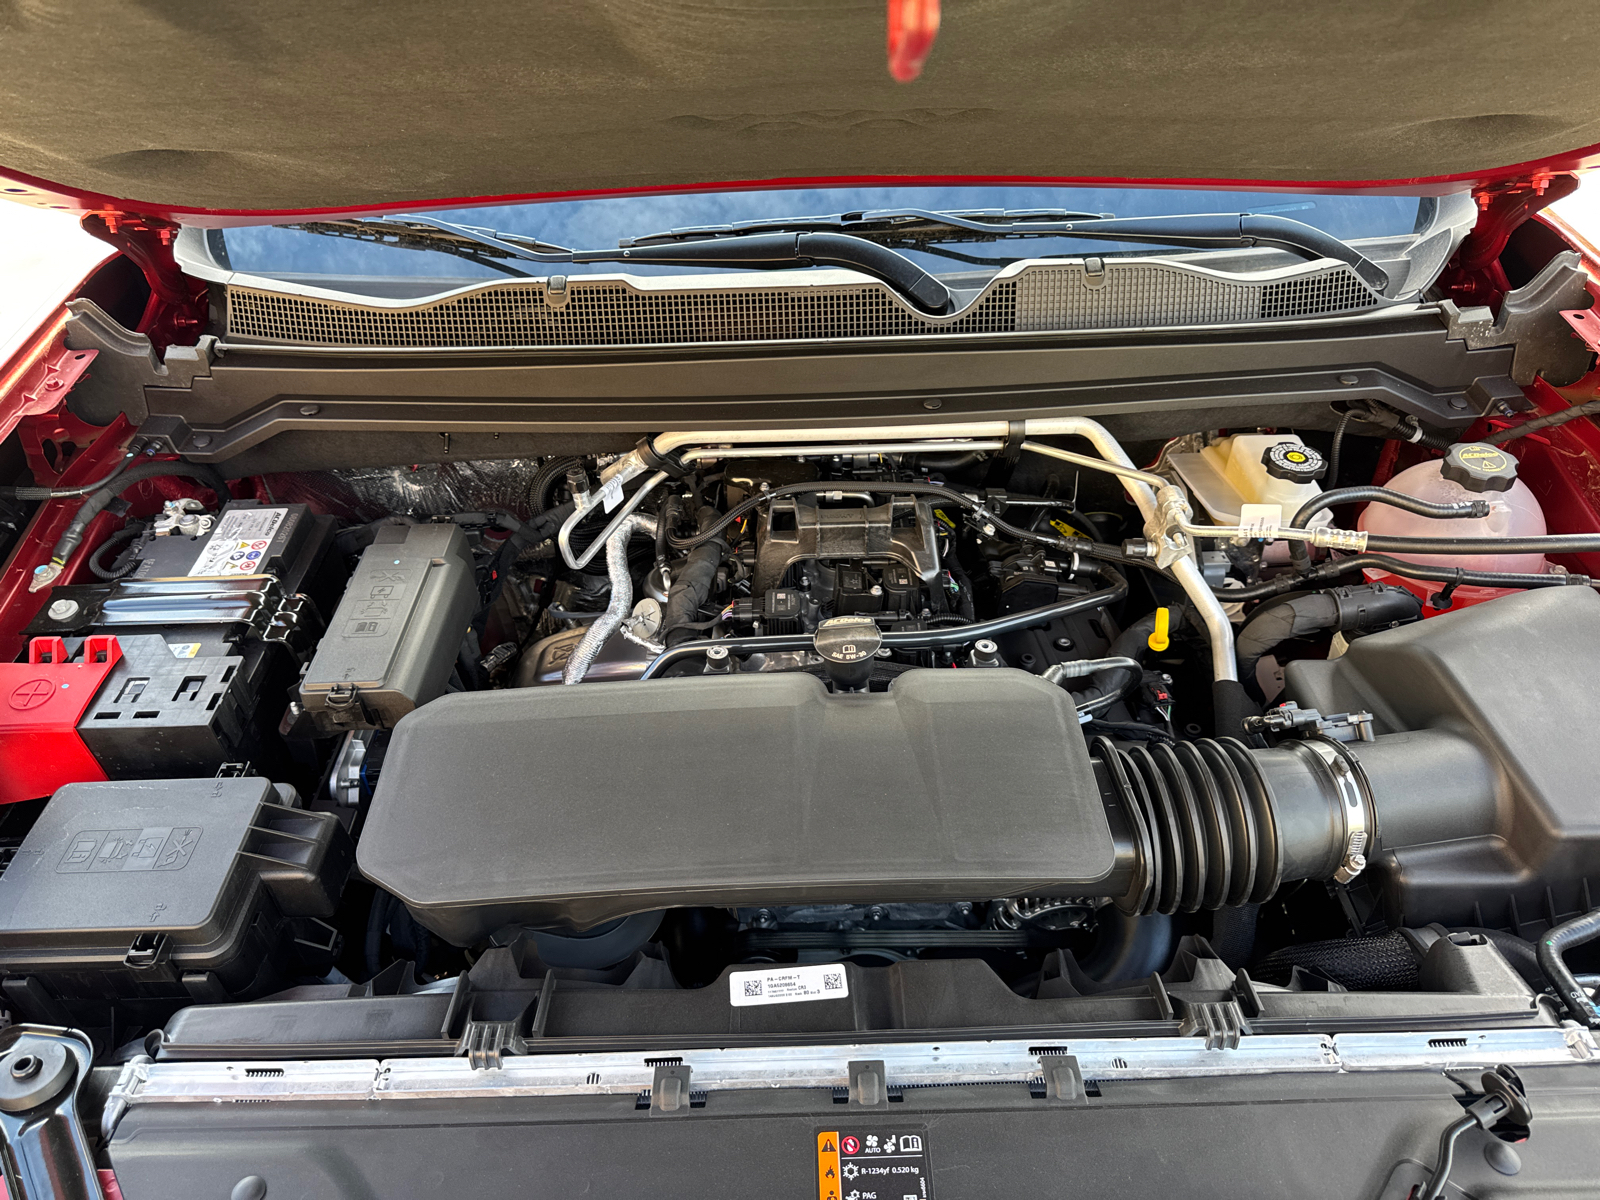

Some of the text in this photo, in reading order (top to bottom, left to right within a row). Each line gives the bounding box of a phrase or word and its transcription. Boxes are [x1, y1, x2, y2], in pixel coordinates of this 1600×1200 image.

[265, 512, 282, 537] ACDelco
[824, 617, 872, 627] ACDelco
[831, 651, 844, 659] SAE
[861, 1165, 920, 1176] R-1234yf 0.520 kg
[862, 1191, 877, 1200] PAG
